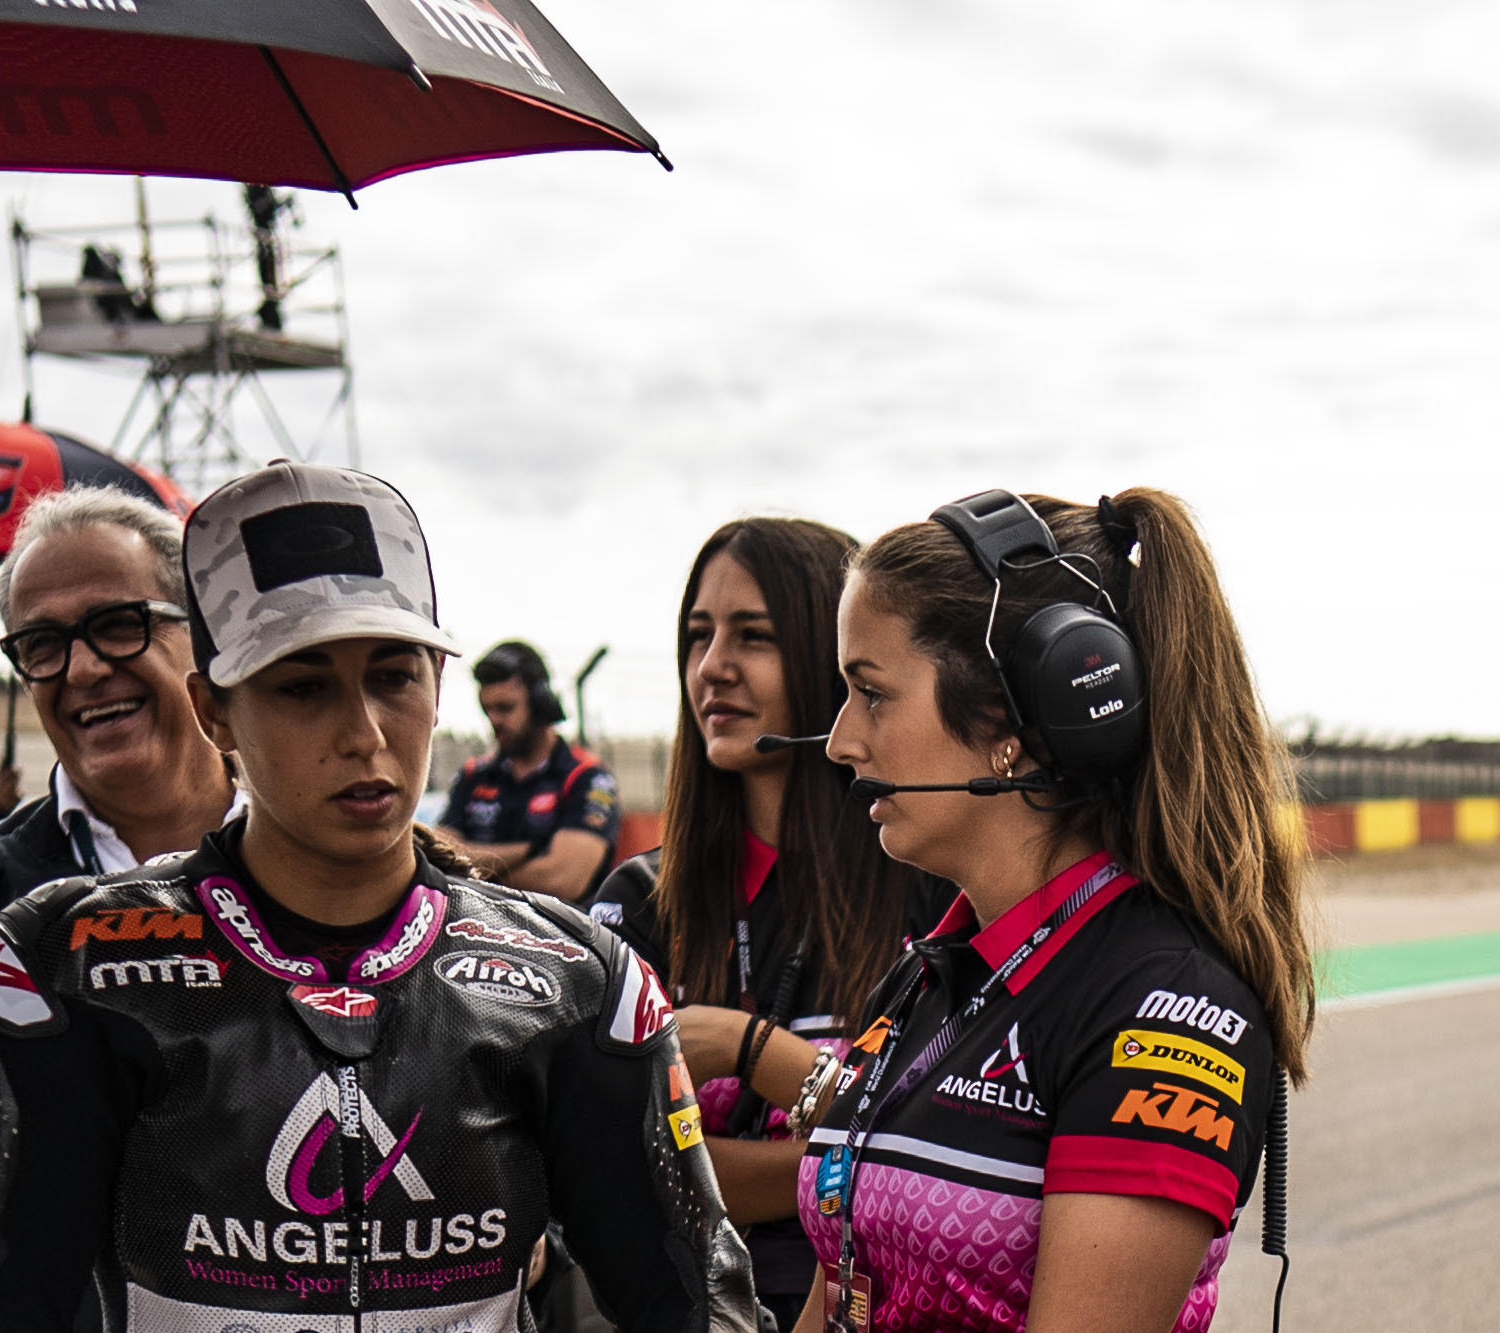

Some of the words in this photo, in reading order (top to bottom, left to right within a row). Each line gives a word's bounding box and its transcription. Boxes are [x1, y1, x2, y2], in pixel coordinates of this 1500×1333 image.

[1071, 662, 1121, 688] PELTOR
[1089, 699, 1125, 719] Lolo
[70, 906, 204, 951] KTM
[211, 887, 316, 978] alpinestars
[360, 895, 435, 979] alpinestars
[445, 956, 554, 999] Airoh
[1135, 989, 1249, 1046] moto3
[1147, 1043, 1240, 1085] DUNLOP
[1111, 1082, 1236, 1151] KTM
[183, 1207, 508, 1265] ANGELUSS
[184, 1258, 277, 1291] Women
[368, 1257, 503, 1292] Management
